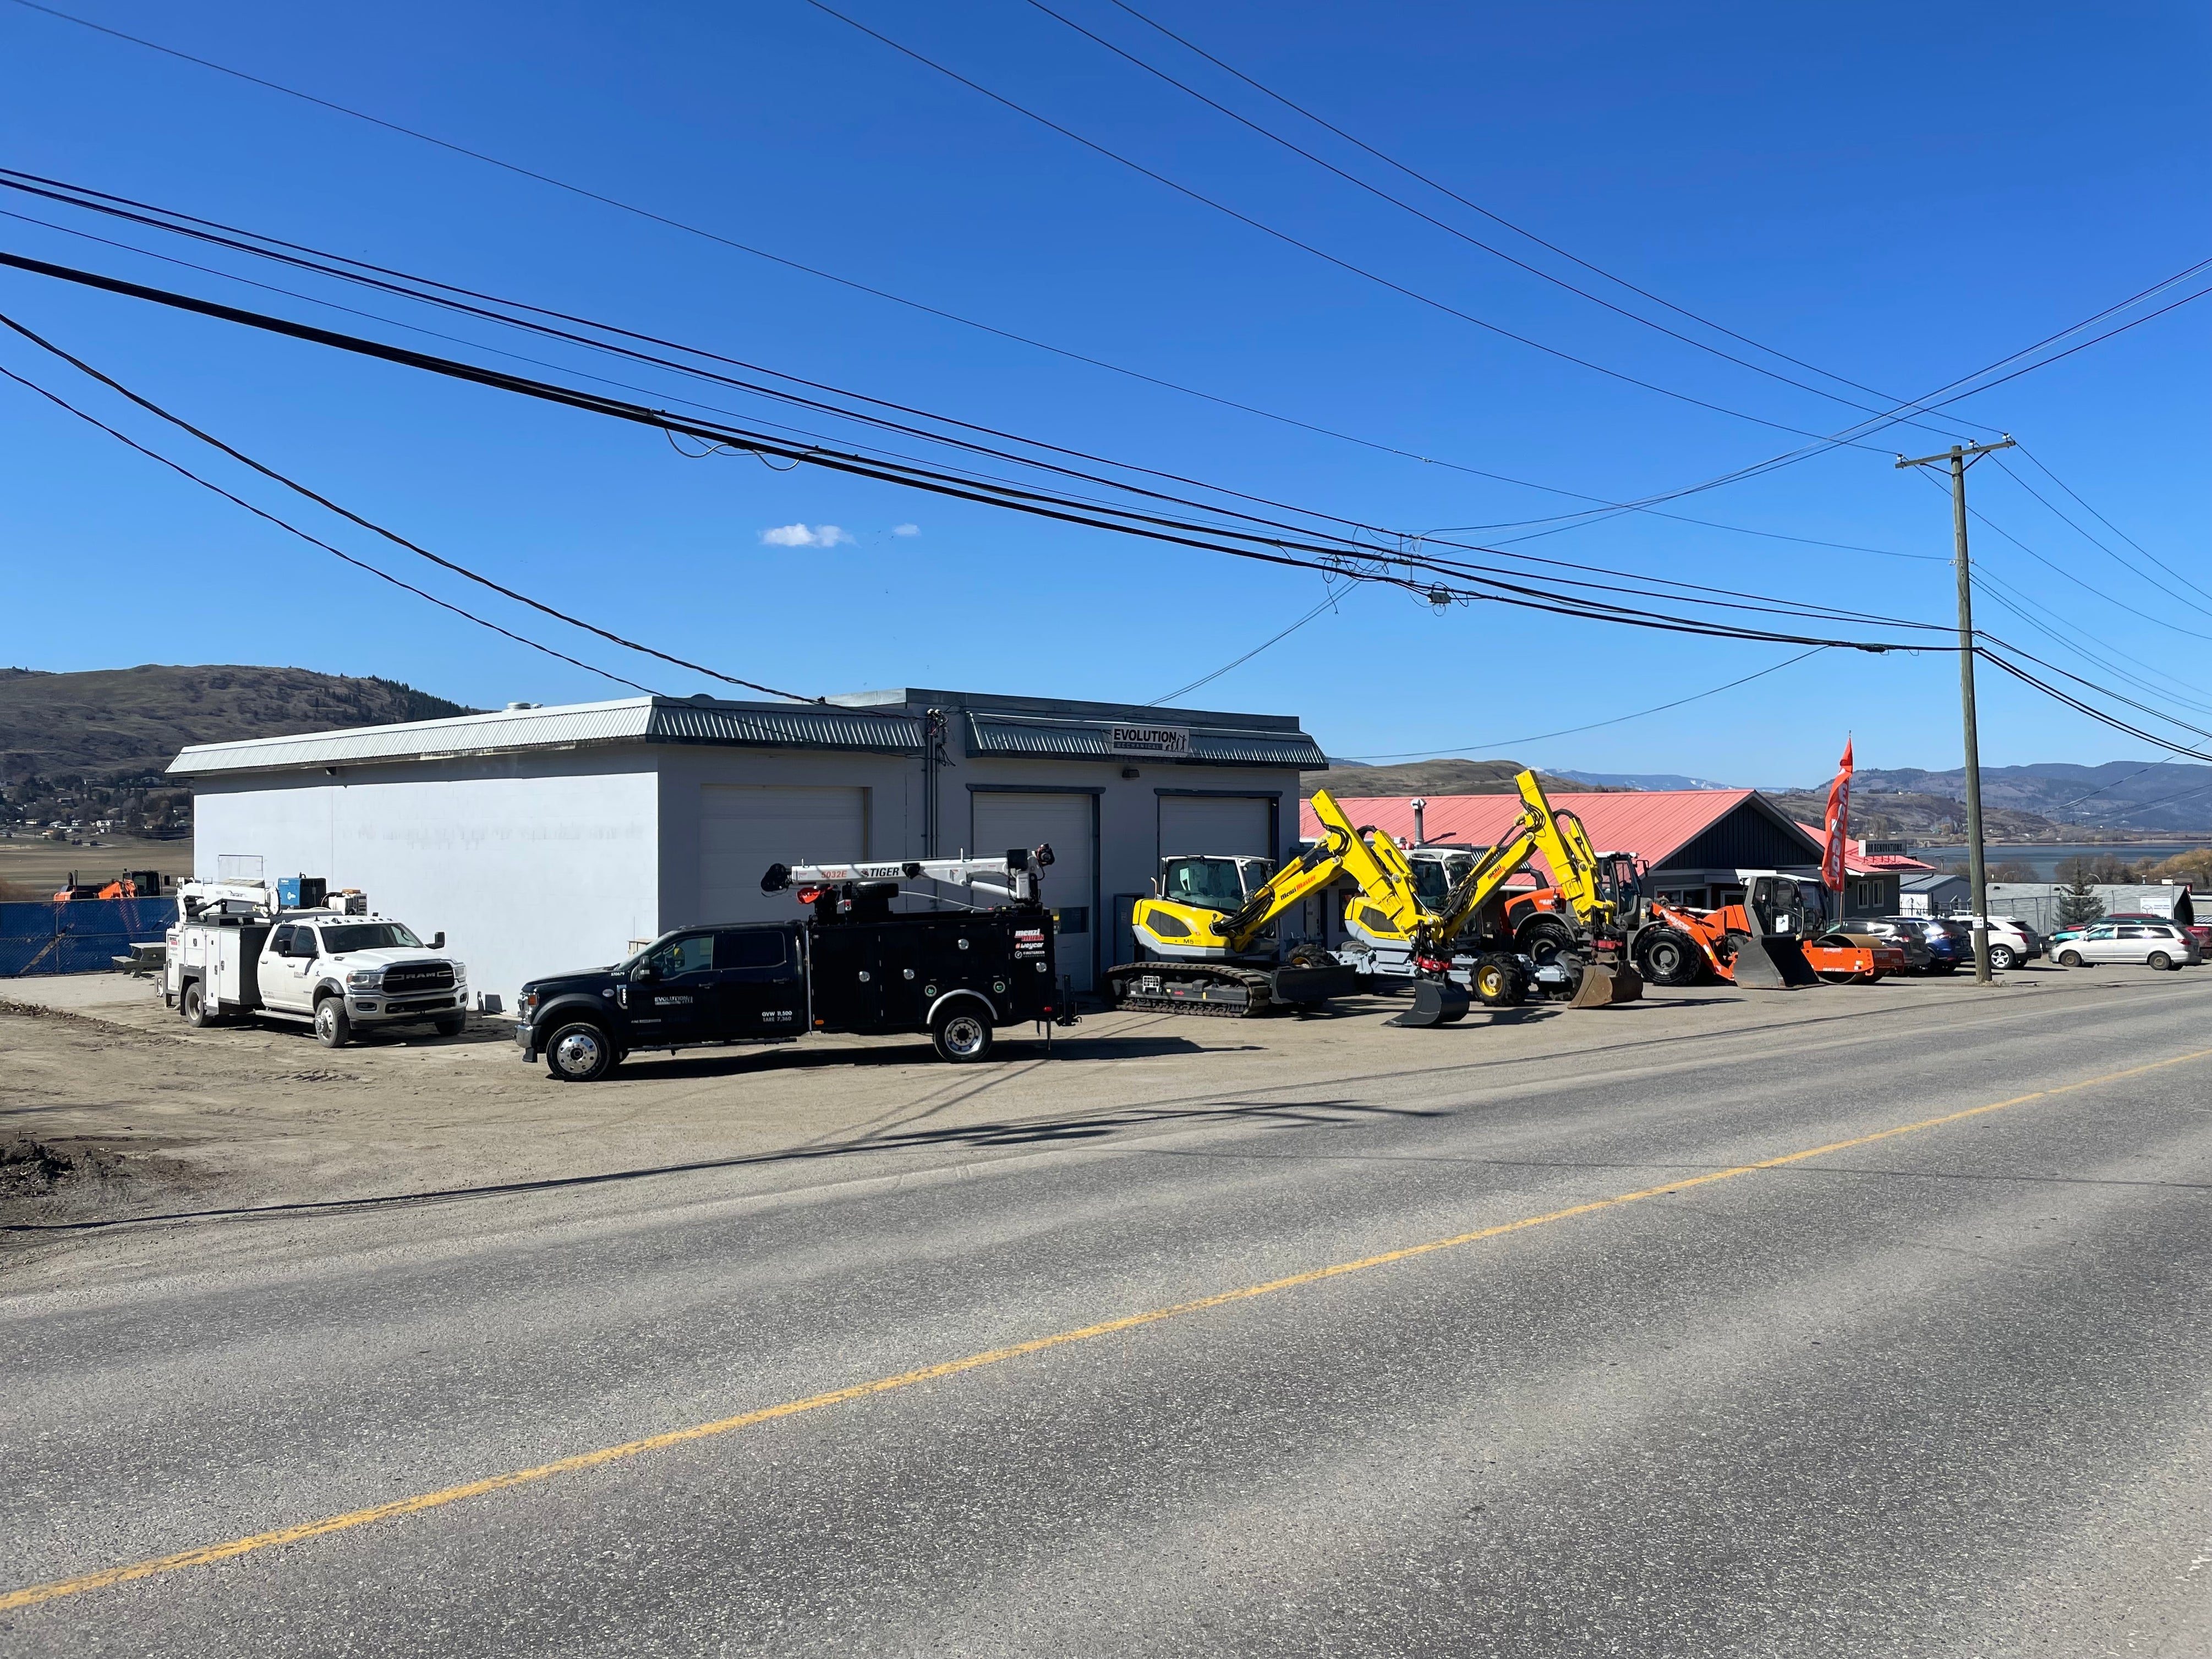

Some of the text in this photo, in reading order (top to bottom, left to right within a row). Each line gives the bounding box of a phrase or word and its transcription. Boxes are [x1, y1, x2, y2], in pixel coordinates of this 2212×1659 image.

[1114, 728, 1176, 742] EVOLUTION
[1874, 844, 1902, 852] RENOVATIONS
[870, 867, 900, 877] TIGER
[1280, 875, 1316, 900] Menzi Master
[1664, 912, 1692, 932] weycor
